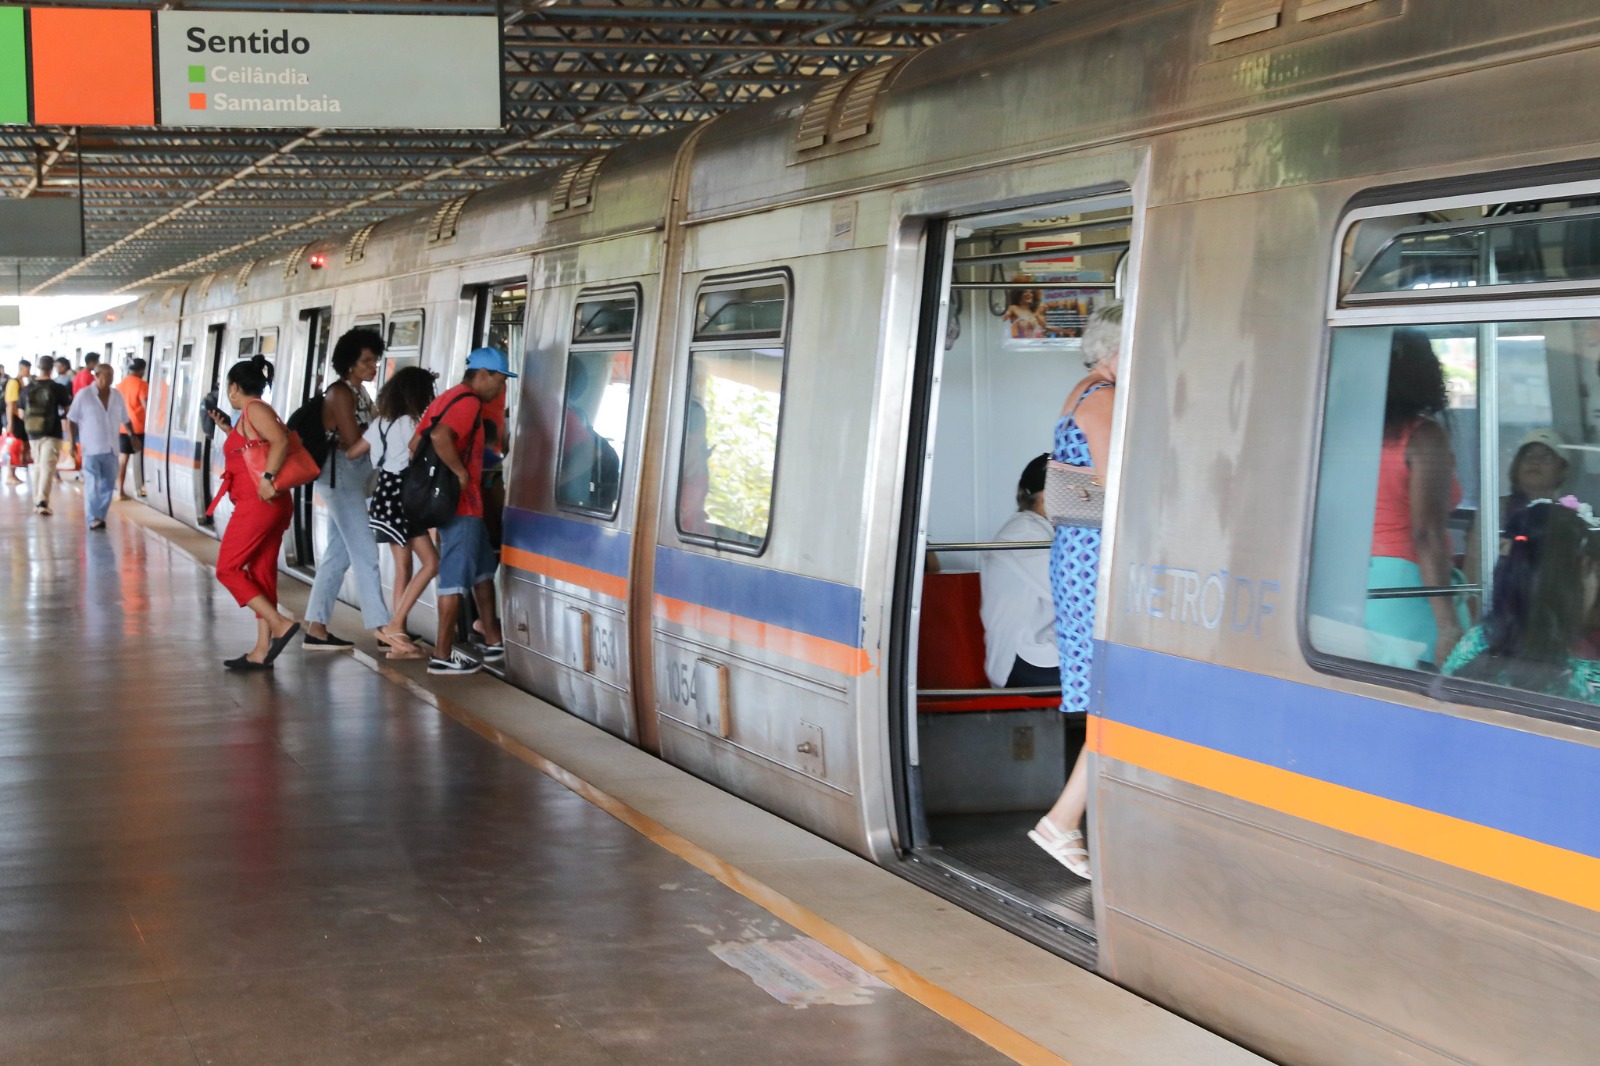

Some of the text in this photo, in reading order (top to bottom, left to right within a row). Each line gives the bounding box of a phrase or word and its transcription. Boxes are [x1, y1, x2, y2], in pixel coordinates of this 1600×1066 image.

[186, 26, 310, 55] Sentido
[210, 65, 309, 85] Ceilândia
[213, 92, 342, 113] Samambaia
[1231, 576, 1281, 638] DF
[592, 625, 617, 670] 053
